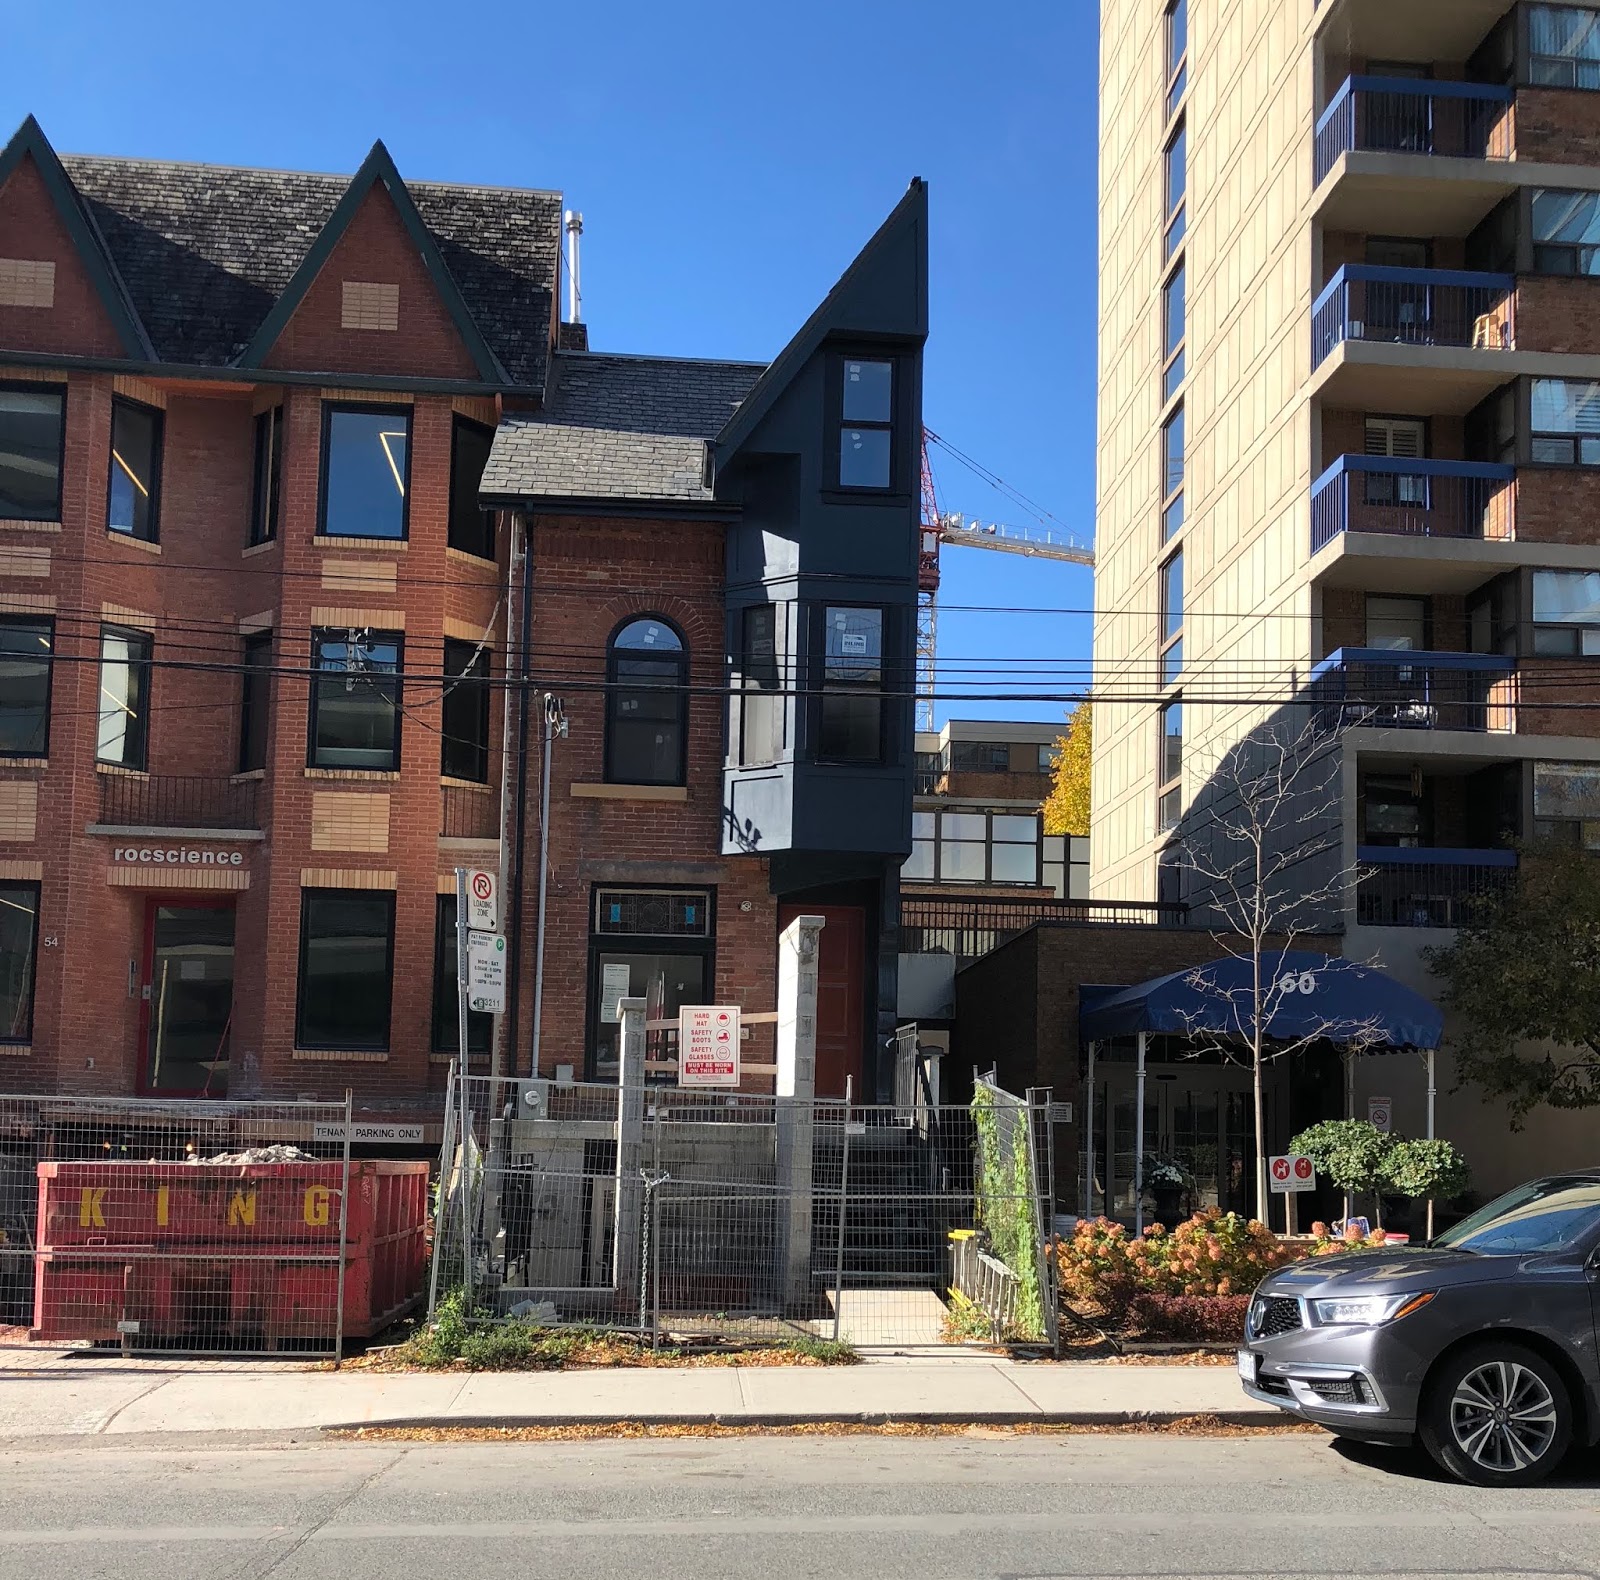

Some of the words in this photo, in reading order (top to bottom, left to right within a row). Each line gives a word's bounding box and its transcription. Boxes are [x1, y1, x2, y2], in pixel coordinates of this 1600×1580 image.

[114, 847, 243, 865] rocscience
[473, 900, 492, 909] LOADING
[477, 908, 489, 917] ZONE
[44, 937, 58, 947] 54
[1280, 972, 1315, 994] 60
[315, 1127, 351, 1137] TENAN
[355, 1128, 395, 1138] PARKING
[398, 1129, 422, 1138] ONLY
[80, 1184, 330, 1227] KING
